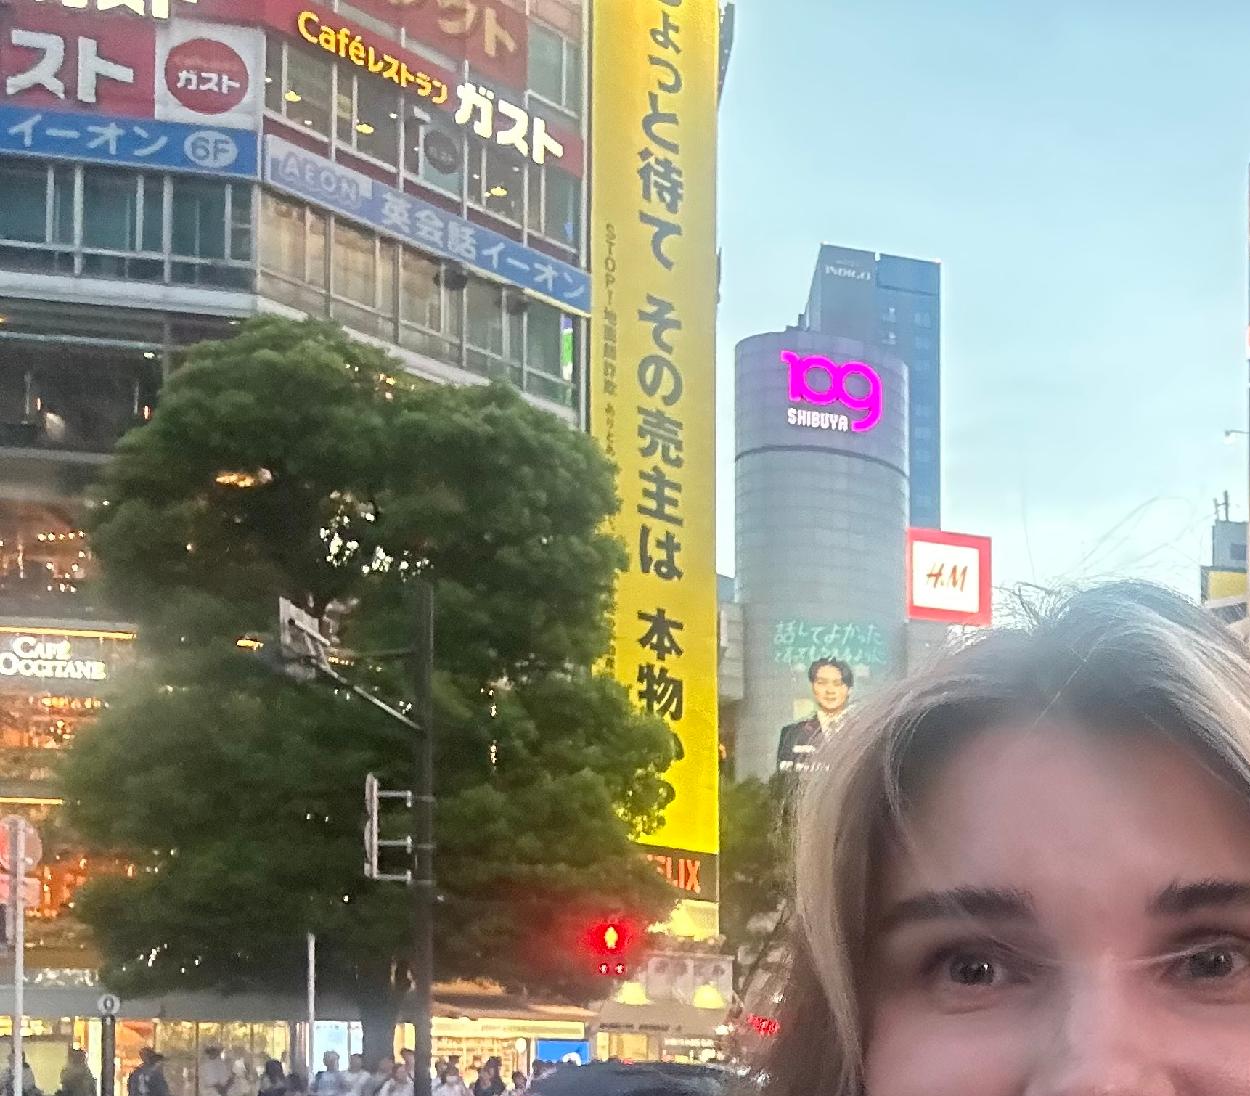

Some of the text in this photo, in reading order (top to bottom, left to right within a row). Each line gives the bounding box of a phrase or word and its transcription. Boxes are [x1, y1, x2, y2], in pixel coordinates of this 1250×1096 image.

[177, 69, 241, 94] ガスト
[8, 114, 229, 160] イーオン 6F
[455, 82, 564, 164] ガスト
[636, 0, 685, 271] ょっと待て
[381, 191, 476, 261] 英会話
[481, 242, 586, 299] イーオン
[780, 350, 884, 432] 109
[787, 408, 849, 432] SHIBUYA
[637, 293, 684, 581] その売主は
[926, 562, 968, 593] HM
